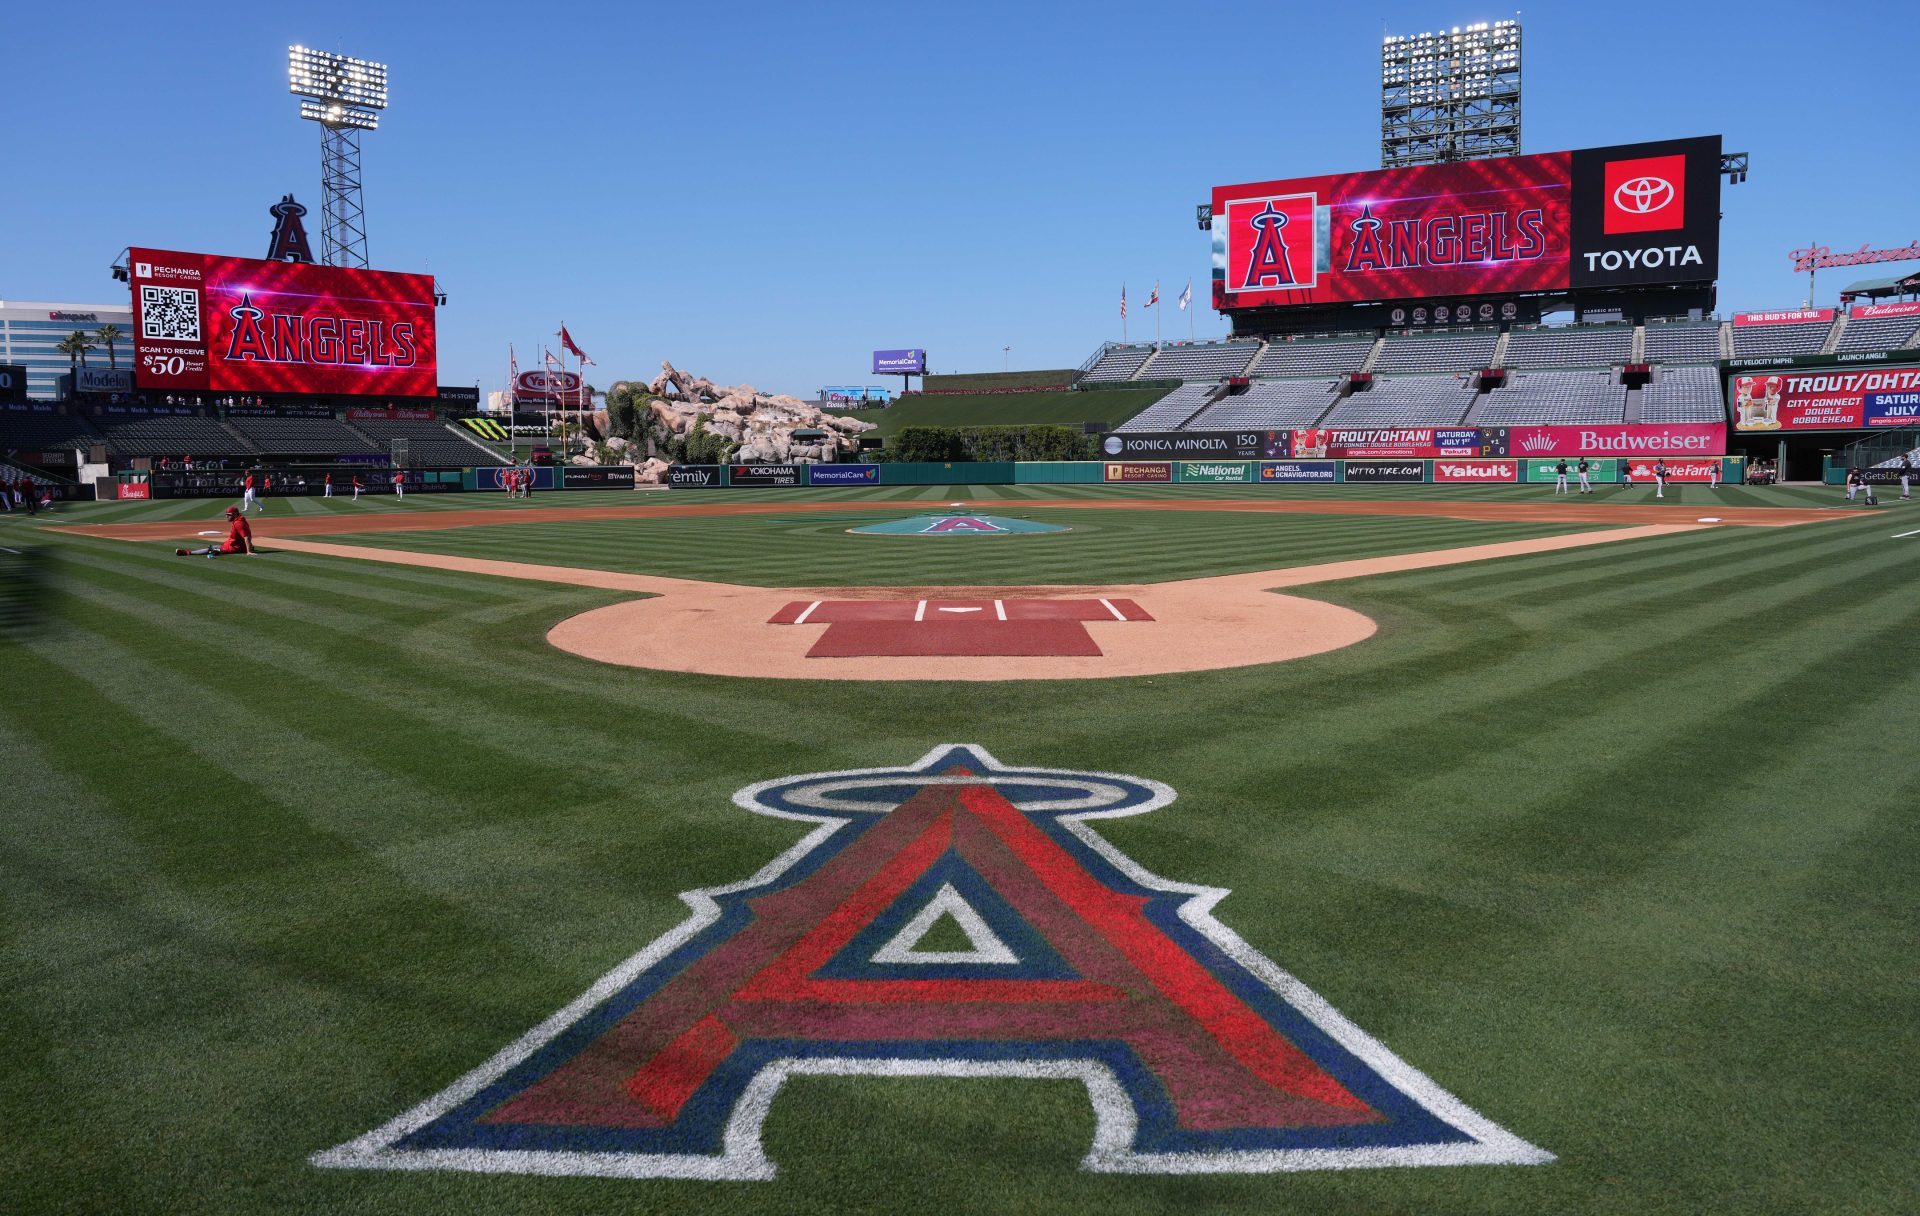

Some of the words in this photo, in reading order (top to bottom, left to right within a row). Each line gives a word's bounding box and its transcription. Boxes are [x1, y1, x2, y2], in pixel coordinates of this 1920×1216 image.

[1345, 204, 1546, 273] ANGELS
[1583, 245, 1703, 272] TOYOTA
[154, 266, 201, 276] PECHANGA
[1764, 313, 1787, 321] BUD'S
[1788, 311, 1802, 319] FOR
[1803, 310, 1820, 318] YOU.
[1862, 305, 1919, 316] Budweiser
[224, 292, 416, 367] ANGELS
[174, 348, 205, 356] RECEIVE
[1837, 353, 1862, 361] LAUNCH
[1863, 352, 1888, 360] ANGLE:
[143, 355, 185, 375] $50
[1773, 357, 1794, 365] (MPH):
[1787, 400, 1810, 408] CITY
[1812, 397, 1862, 407] CONNECT
[1884, 406, 1918, 416] JULY
[1792, 416, 1854, 424] BOBBLEHEAD
[1282, 432, 1288, 440] 0
[1331, 430, 1431, 443] TROUT/OHTANI
[1437, 431, 1476, 439] SATURDAY,
[1500, 429, 1505, 437] 0
[1127, 440, 1172, 450] KONICA
[1175, 439, 1228, 450] MINOLTA
[1237, 435, 1257, 446] 150
[1442, 438, 1459, 446] JULY
[1580, 432, 1710, 451] Budweiser
[1500, 447, 1505, 455] 0
[750, 467, 795, 475] YOKOHAMA
[813, 470, 864, 480] MemorialCare
[1200, 465, 1245, 476] National
[1275, 471, 1333, 479] OCNAVIGATOR.ORG
[1347, 467, 1376, 476] NITTO
[1379, 466, 1421, 477] TIRE.COM
[1440, 465, 1512, 478] Yakult
[1652, 465, 1684, 476] Sate
